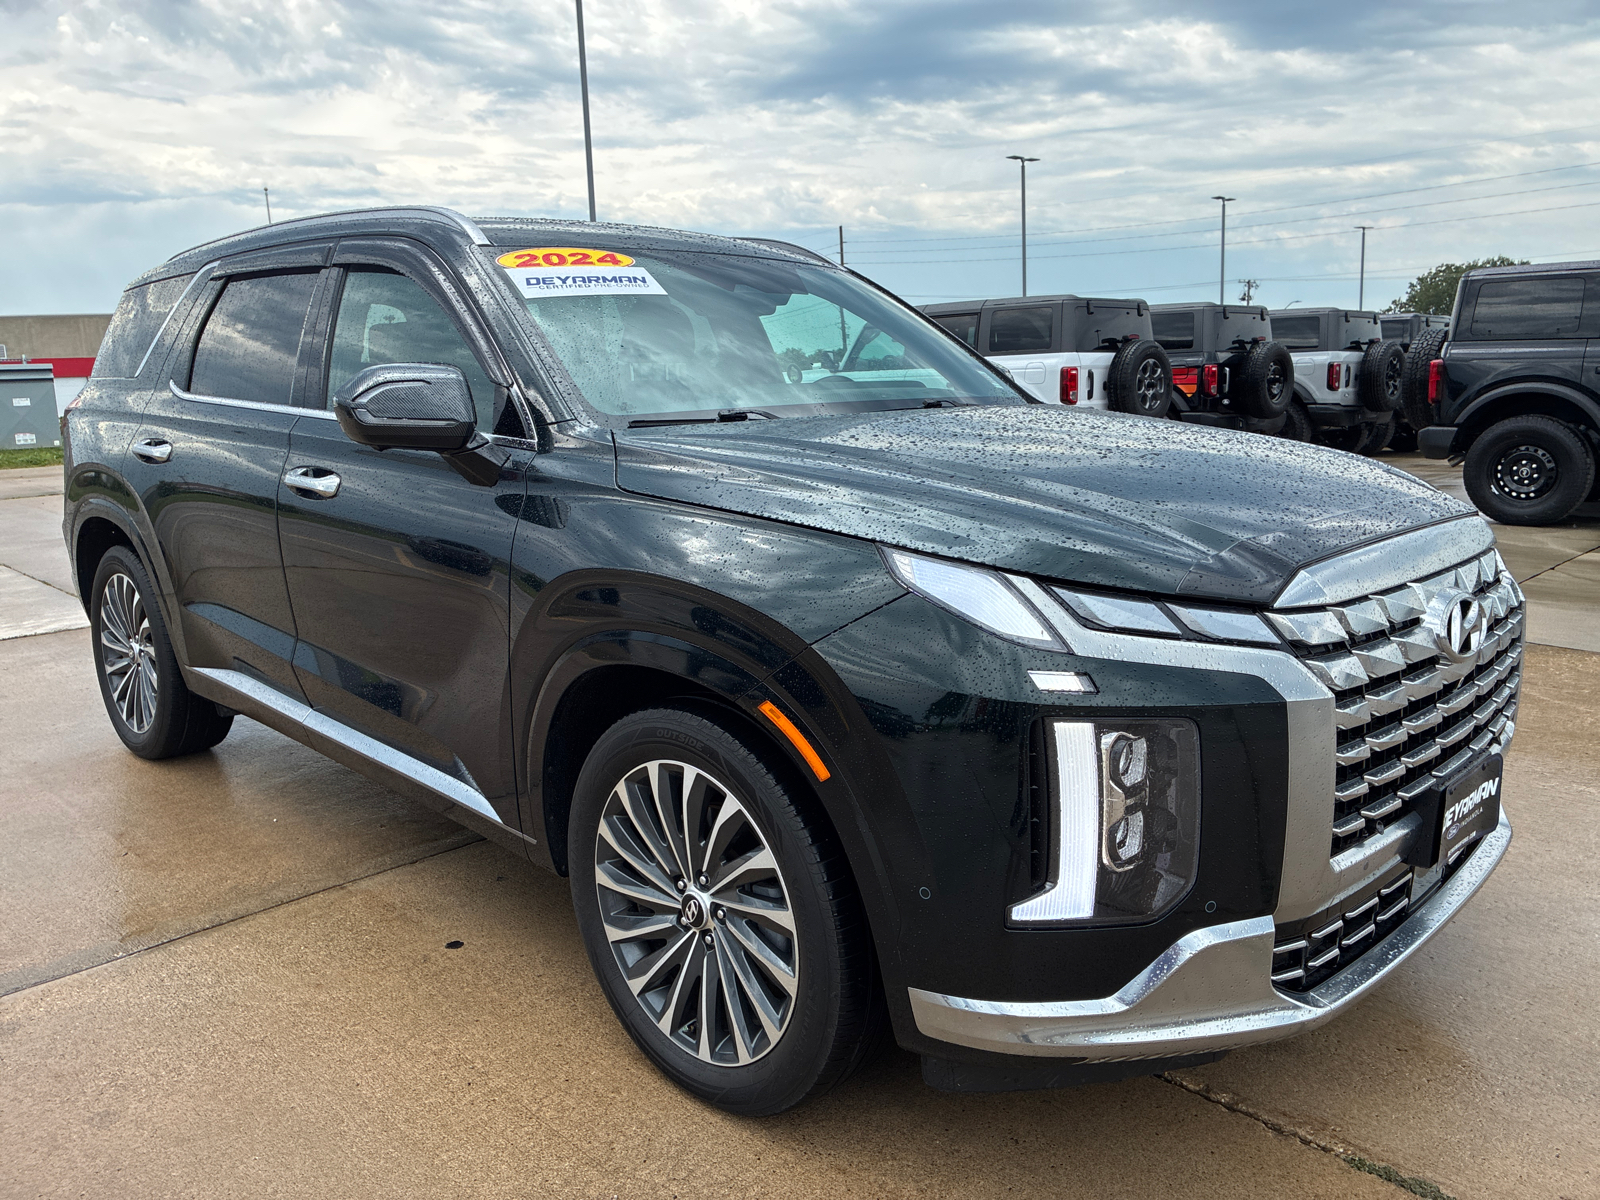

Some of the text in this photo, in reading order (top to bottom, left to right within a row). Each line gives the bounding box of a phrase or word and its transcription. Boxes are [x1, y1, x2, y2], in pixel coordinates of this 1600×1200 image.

[514, 252, 623, 268] 2024
[525, 275, 648, 287] DEYARMAN
[656, 729, 705, 751] OUTSIDE
